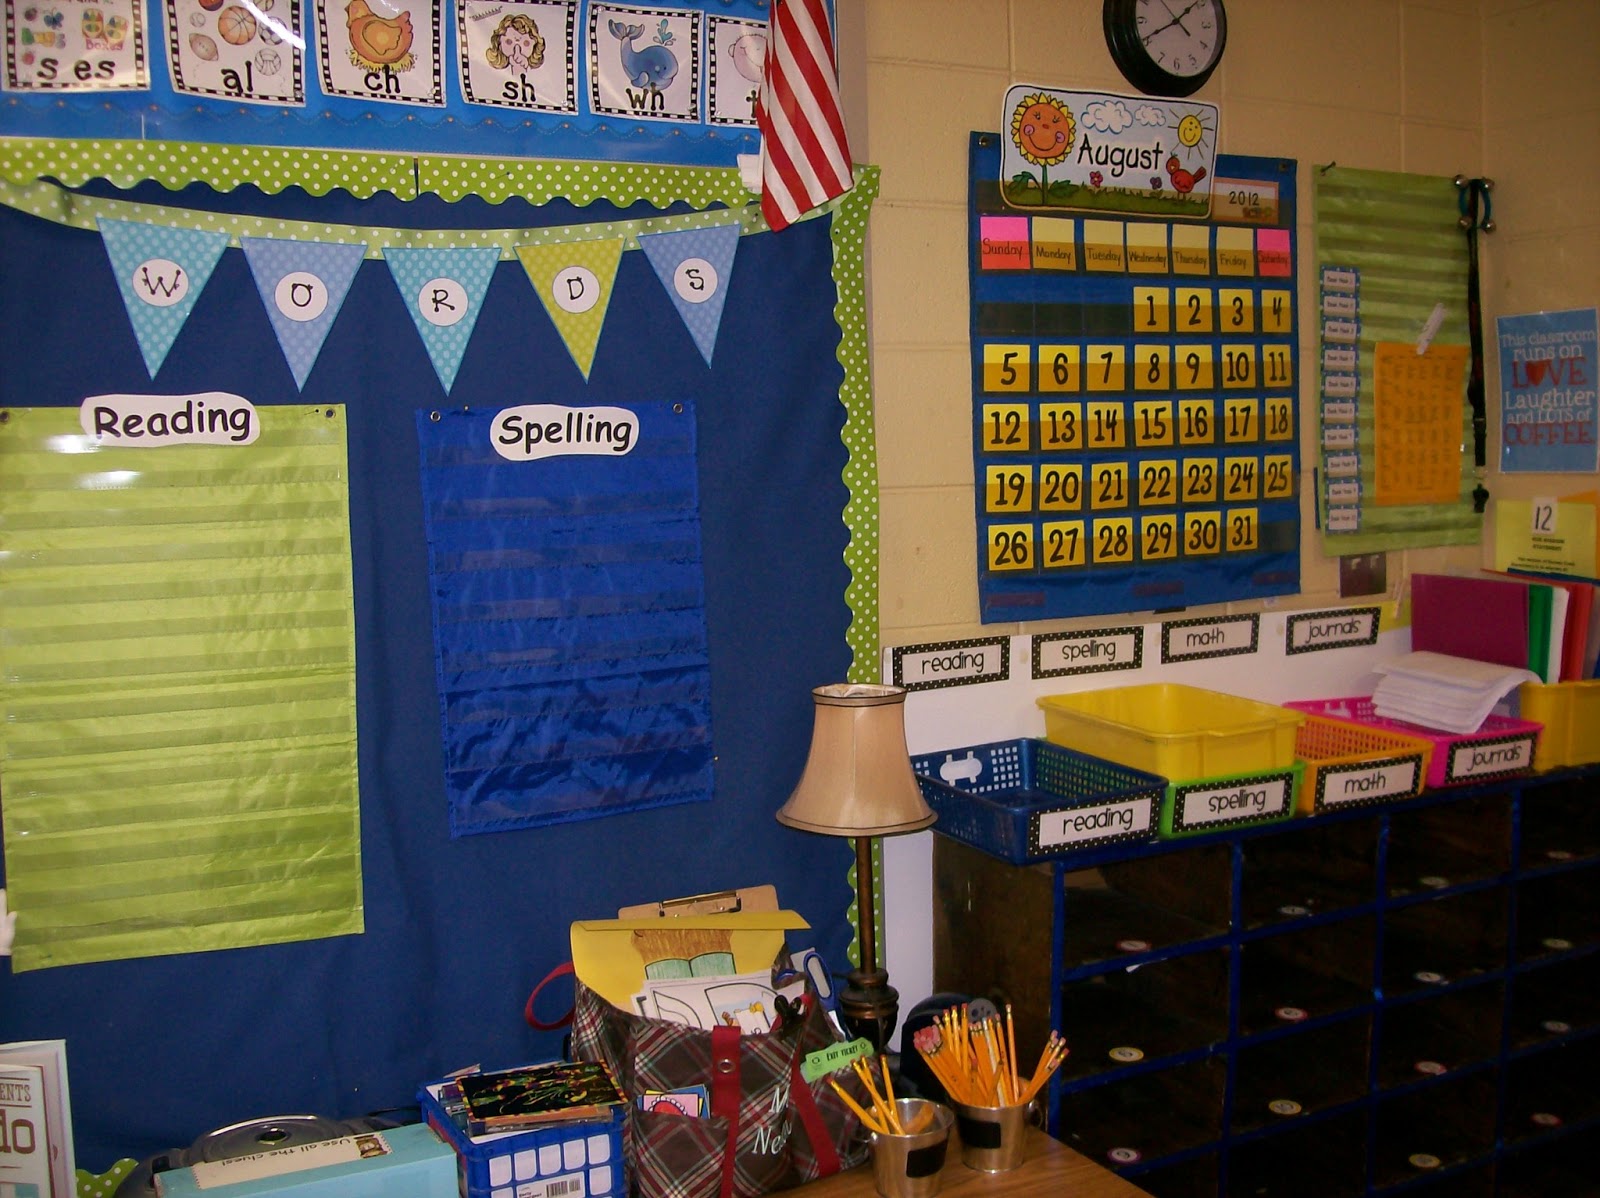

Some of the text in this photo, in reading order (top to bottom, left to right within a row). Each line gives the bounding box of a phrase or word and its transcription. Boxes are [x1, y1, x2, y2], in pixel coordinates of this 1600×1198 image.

[37, 58, 116, 81] s es
[220, 60, 254, 96] al
[364, 64, 401, 94] ch
[502, 73, 536, 102] sh
[626, 82, 665, 111] wh
[1077, 134, 1164, 177] August
[1229, 191, 1260, 206] 2012
[982, 237, 1023, 260] Sunday
[1036, 246, 1071, 264] Monday
[1086, 248, 1121, 266] Tuesday
[1128, 251, 1167, 268] Wednesday
[1175, 251, 1207, 269] Thursday
[1220, 254, 1247, 269] Friday
[141, 266, 706, 312] W O R D S
[1147, 295, 1282, 327] 1 2 3 4
[1502, 333, 1526, 347] This
[1513, 344, 1583, 361] runs on
[1000, 352, 1287, 385] 5 6 7 8 9 10 11
[1504, 387, 1595, 412] Laughter
[93, 401, 251, 444] Reading
[990, 403, 1288, 444] 12 13 14 15 16 17 18
[1507, 410, 1533, 424] and
[1577, 407, 1593, 421] of
[499, 414, 632, 453] Spelling
[995, 461, 1288, 506] 19 20 21 22 23 24 25
[1535, 505, 1553, 531] 12
[994, 516, 1253, 565] 26 27 28 29 30 31
[1186, 627, 1225, 647] math
[1305, 617, 1361, 644] journals
[921, 651, 984, 675] reading
[1061, 639, 1116, 662] spelling
[1466, 745, 1522, 772] journals
[1344, 772, 1386, 793] math
[1208, 789, 1267, 814] spelling
[1062, 807, 1133, 835] reading
[221, 1138, 351, 1167] Use all the clues!
